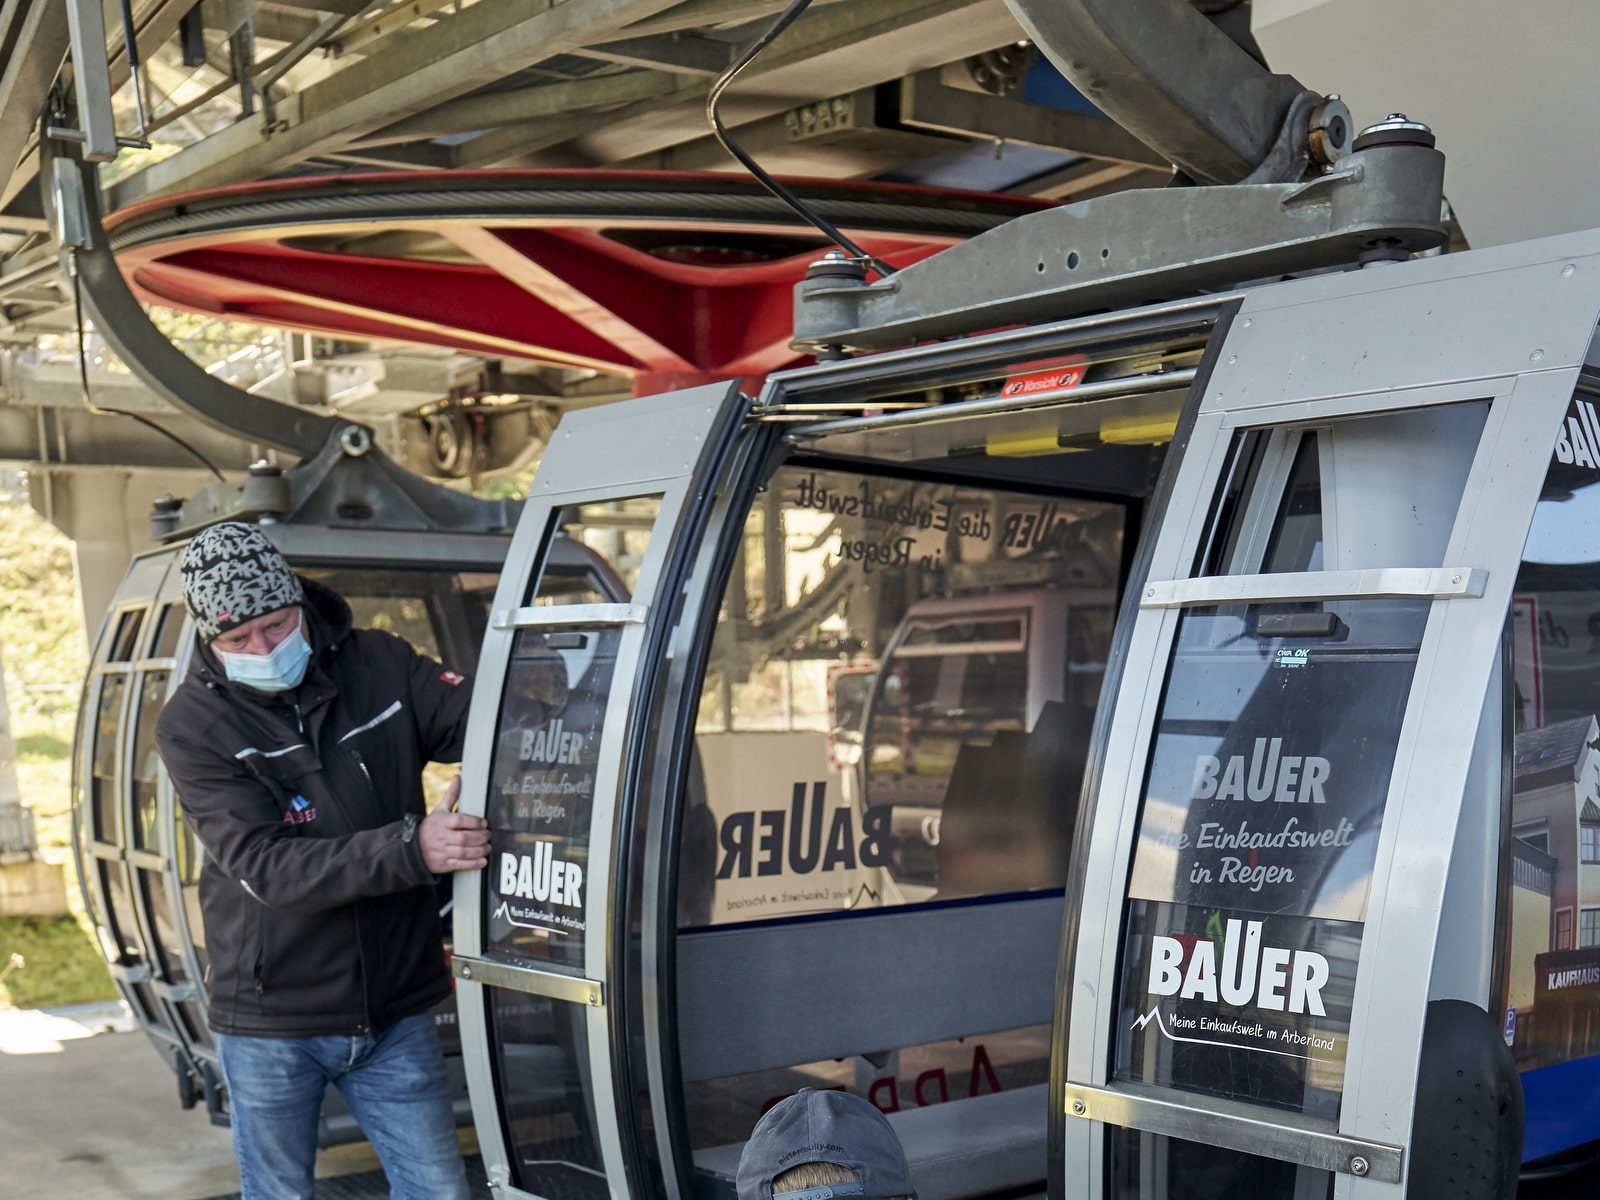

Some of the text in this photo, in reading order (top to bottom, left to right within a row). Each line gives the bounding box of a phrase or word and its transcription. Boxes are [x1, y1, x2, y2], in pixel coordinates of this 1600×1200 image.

[1294, 648, 1310, 657] OK
[519, 718, 584, 765] BAUER
[1191, 738, 1331, 804] BAUER
[531, 800, 566, 824] Regen
[1196, 817, 1355, 850] Einkaufswelt
[500, 841, 583, 909] BAUER
[1190, 856, 1296, 893] in Regen
[1148, 918, 1330, 1017] BAUER
[1547, 966, 1600, 990] KAUFHAUS
[1169, 1013, 1335, 1051] Meine Einkaufswelt im Arberland
